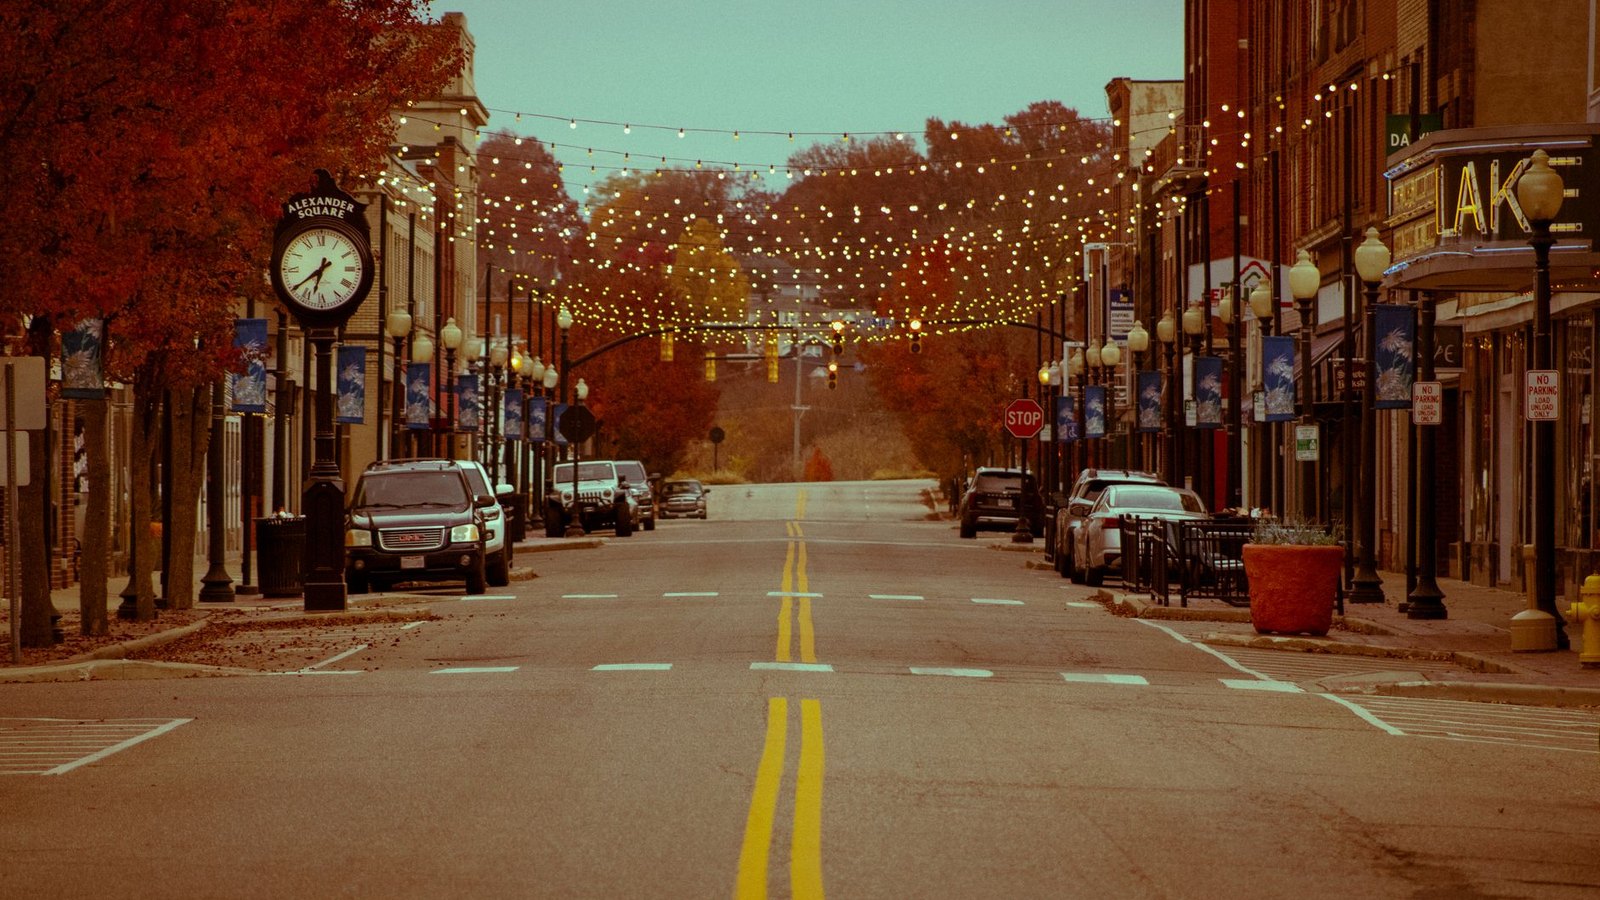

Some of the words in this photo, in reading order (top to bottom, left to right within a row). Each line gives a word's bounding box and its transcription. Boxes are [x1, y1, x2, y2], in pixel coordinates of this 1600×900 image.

[288, 197, 354, 213] ALEXANDER
[298, 206, 345, 219] SQUARE
[1536, 375, 1549, 385] NO
[1422, 386, 1432, 394] NO
[1528, 386, 1557, 395] PARKING
[1415, 395, 1439, 403] PARKING
[1008, 411, 1041, 426] STOP
